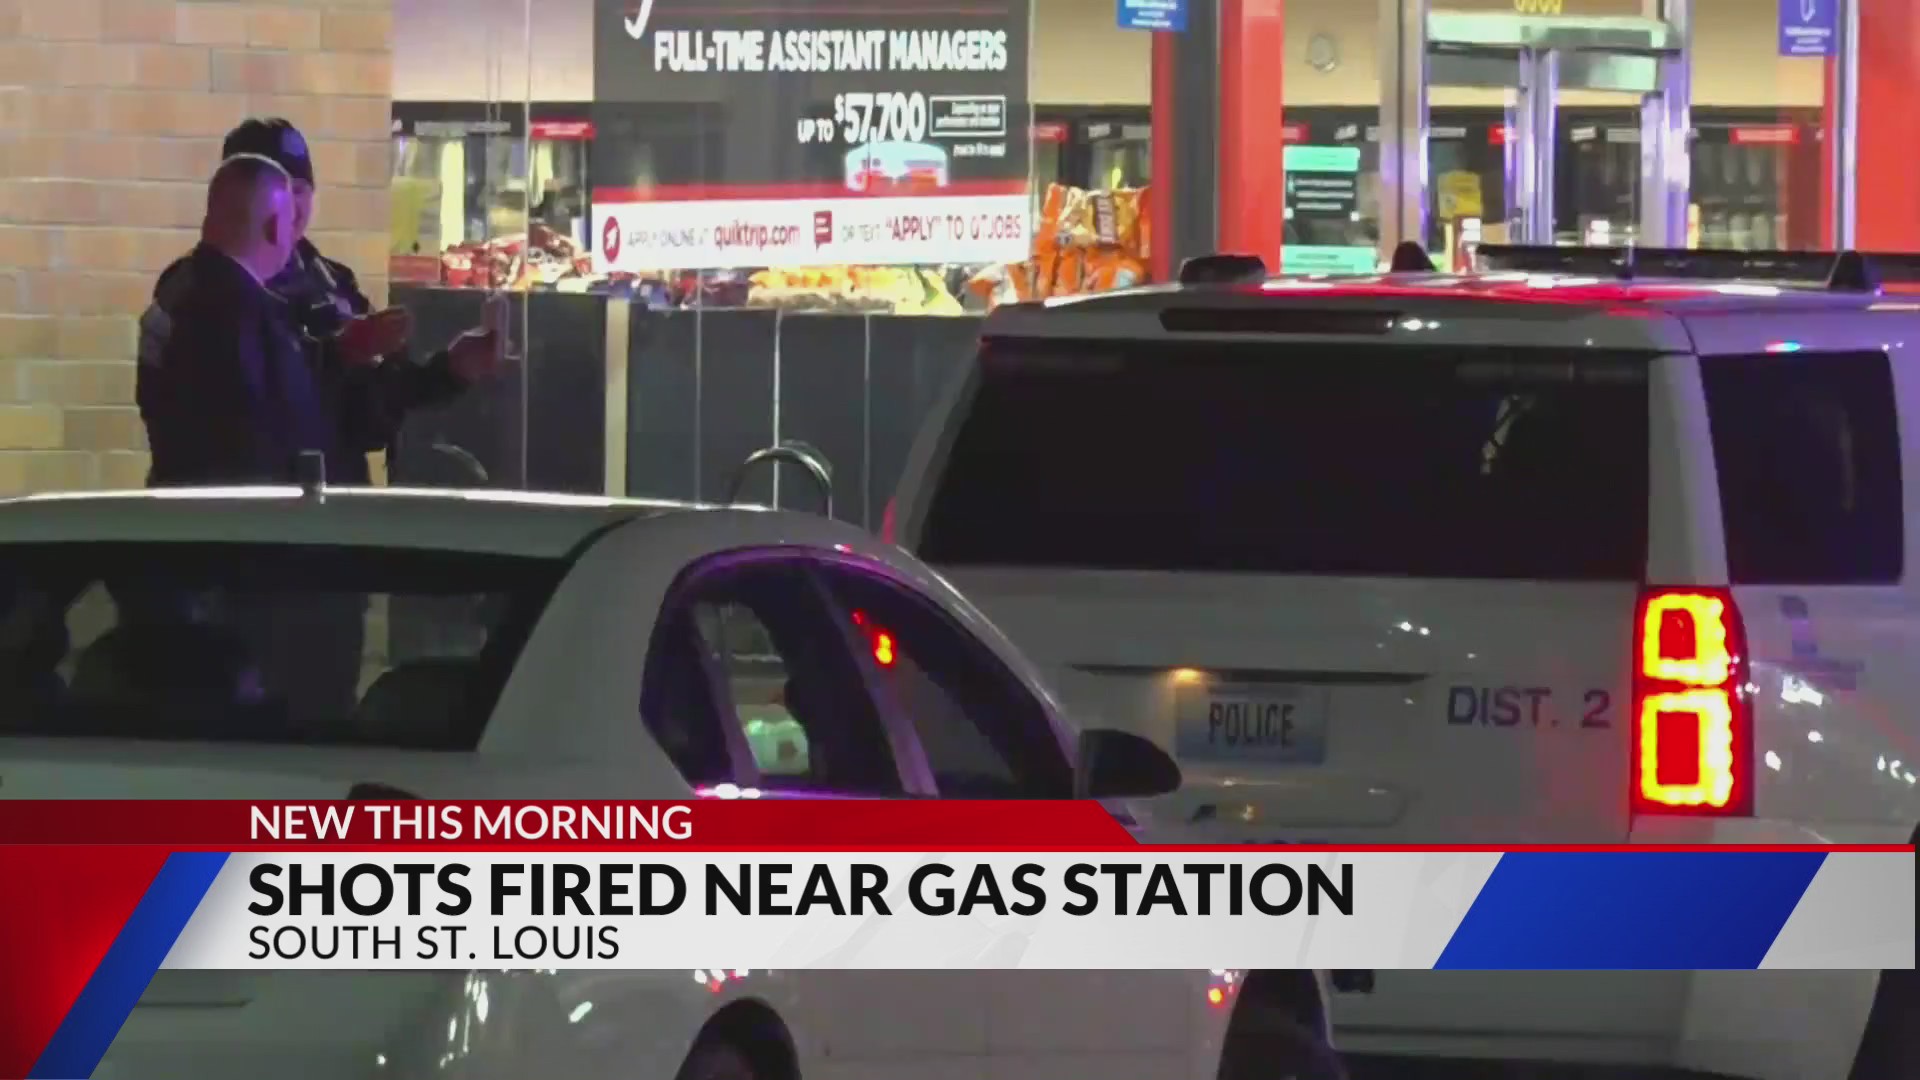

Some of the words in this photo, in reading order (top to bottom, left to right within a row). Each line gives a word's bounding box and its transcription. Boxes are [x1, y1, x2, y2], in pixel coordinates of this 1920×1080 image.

[655, 30, 764, 71] FULL-TIME
[768, 30, 886, 71] ASSISTANT
[889, 30, 1007, 71] MANAGERS
[797, 118, 815, 143] UP
[816, 118, 834, 142] TO
[713, 206, 801, 251] quiktrip.com
[946, 213, 965, 241] TO
[1209, 702, 1296, 748] POLICE
[1447, 685, 1559, 729] DIST.
[1580, 688, 1612, 730] 2
